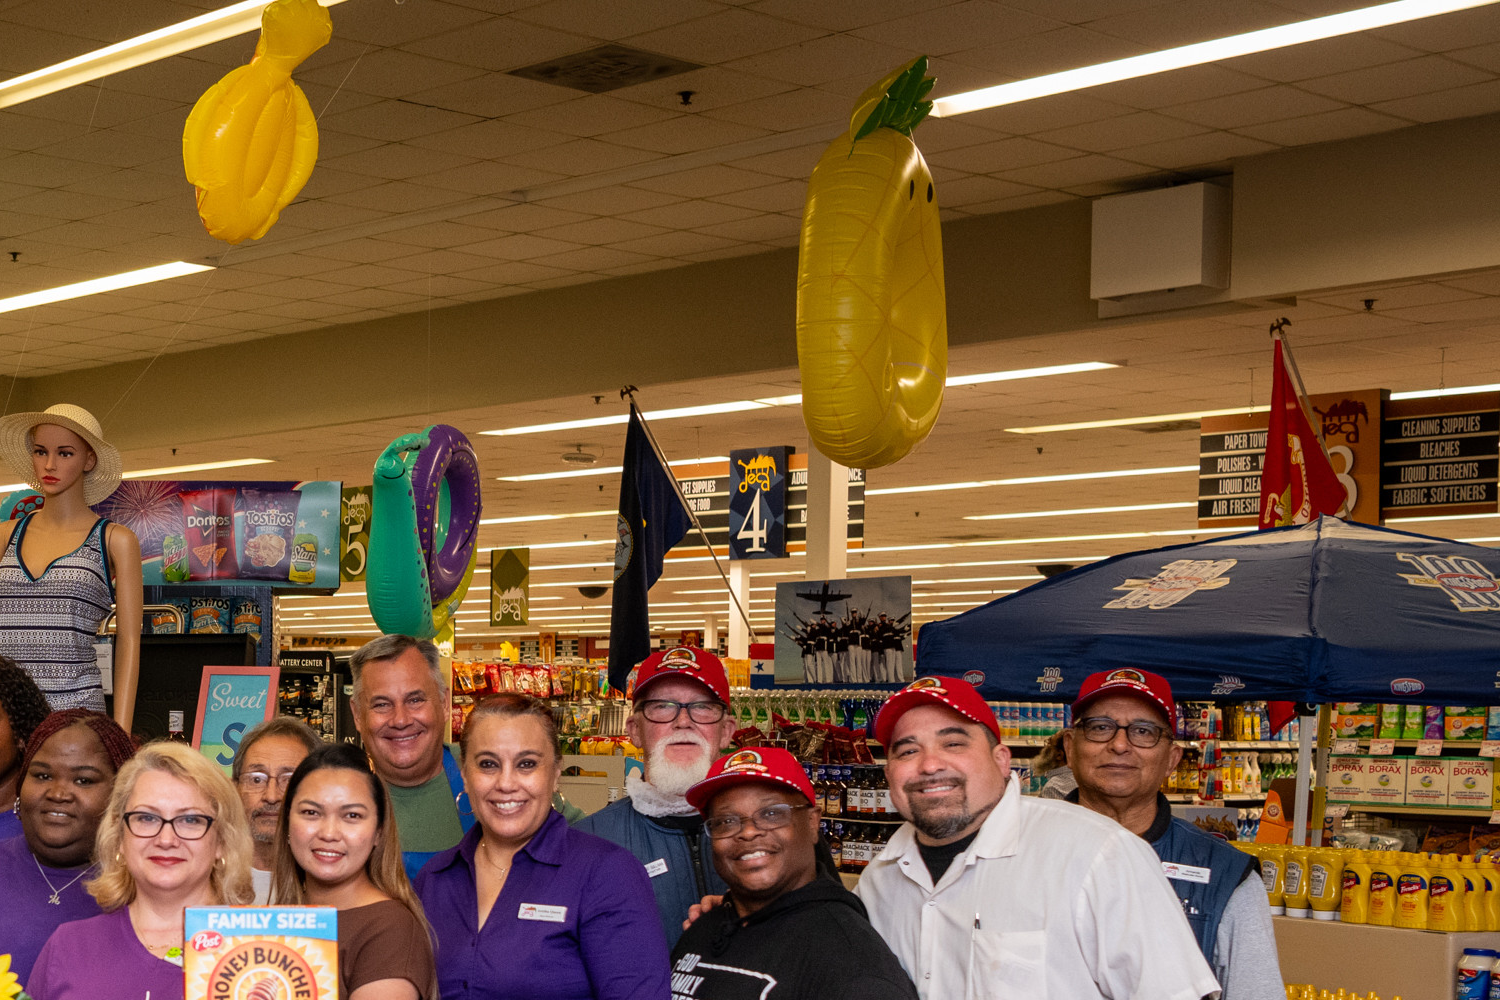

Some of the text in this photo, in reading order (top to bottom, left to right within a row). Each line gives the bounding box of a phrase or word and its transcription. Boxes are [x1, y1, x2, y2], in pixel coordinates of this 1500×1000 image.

[1401, 416, 1481, 437] CLEANING SUPPLIES
[1224, 431, 1268, 450] PAPER TOWE
[1419, 441, 1460, 458] BLEACHES
[1217, 456, 1251, 473] POLISHES
[1400, 462, 1479, 483] LIQUID DETERGENTS
[791, 470, 808, 485] ADUL
[1218, 475, 1262, 494] LIQUID CLEA
[681, 479, 716, 494] PET SUPPLIES
[1392, 484, 1487, 506] FABRIC SOFTENERS
[696, 497, 711, 511] FOOD
[1212, 499, 1228, 516] AIR
[187, 514, 231, 528] Doritos
[736, 488, 767, 553] 4
[345, 521, 367, 576] 5
[301, 658, 323, 667] CENTER
[1393, 680, 1423, 694] KINGSFORD
[210, 682, 268, 712] Sweet
[1331, 764, 1364, 773] BORAX
[1368, 765, 1402, 775] BORAX
[1410, 766, 1445, 776] BORAX
[1453, 767, 1489, 777] BORAX
[207, 912, 317, 929] FAMILY SIZE
[194, 933, 221, 950] Post
[670, 972, 705, 996] AMILY
